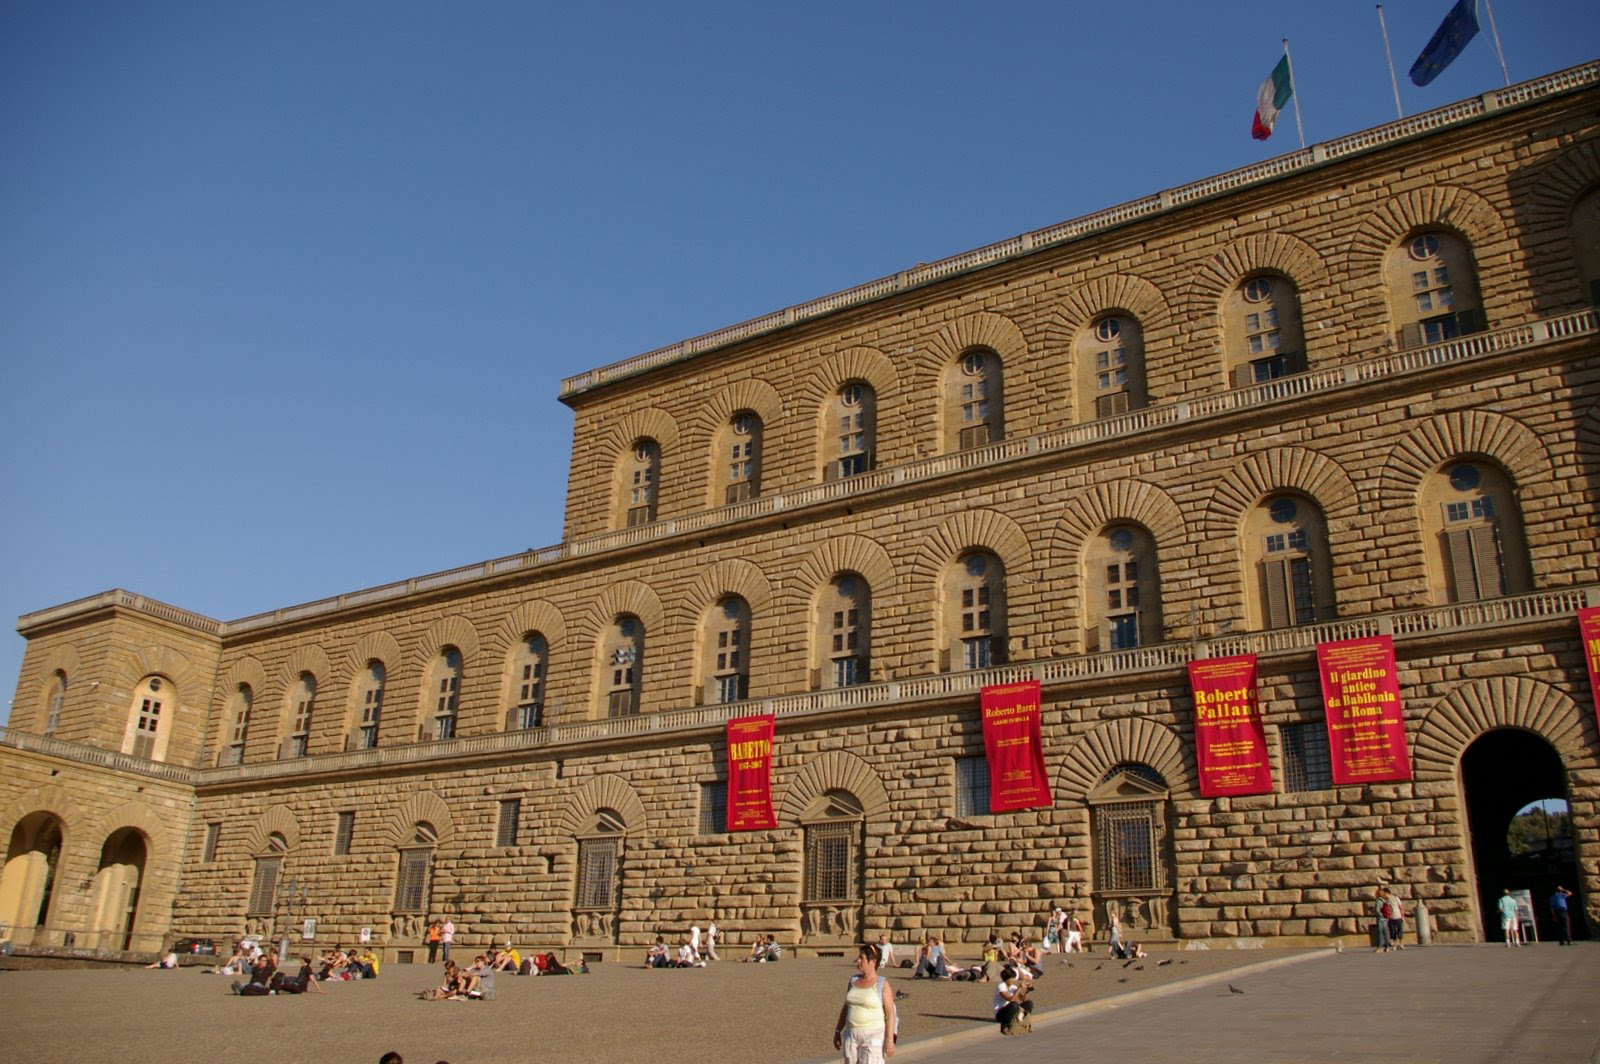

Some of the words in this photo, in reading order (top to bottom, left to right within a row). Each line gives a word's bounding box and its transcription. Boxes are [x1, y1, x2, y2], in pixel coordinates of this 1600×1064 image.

[1330, 671, 1339, 683] Il
[1341, 668, 1386, 684] giardino
[1343, 681, 1376, 694] antico
[1194, 687, 1256, 705] Roberto
[1328, 696, 1341, 708] da
[1343, 691, 1396, 706] Babilonia
[985, 706, 1015, 718] Roberto
[1196, 702, 1258, 720] Fallani
[1343, 709, 1350, 718] a
[1352, 706, 1383, 717] Roma
[730, 740, 770, 761] BABETTO
